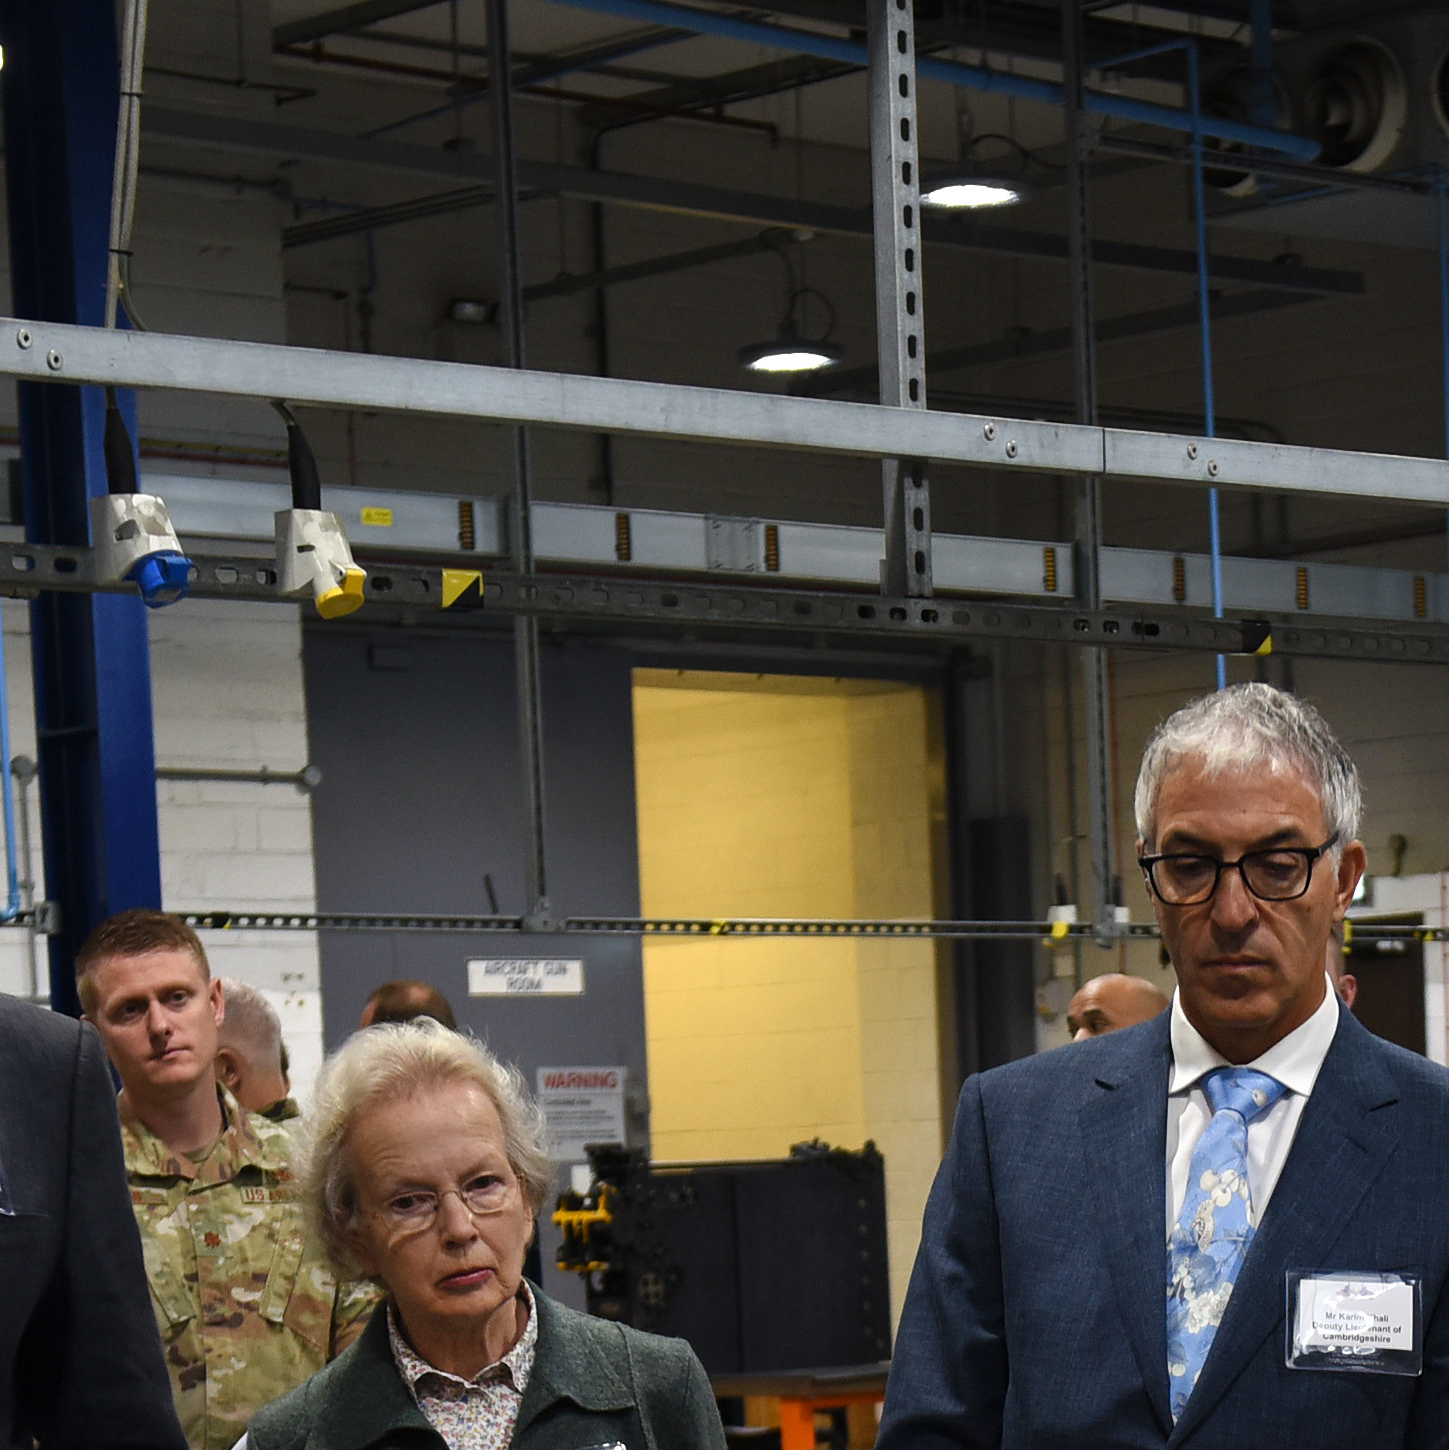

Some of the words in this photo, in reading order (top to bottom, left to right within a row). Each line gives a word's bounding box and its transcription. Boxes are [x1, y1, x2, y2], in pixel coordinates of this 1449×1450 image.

[484, 960, 539, 976] AIRCRAFT
[543, 960, 569, 976] GUN
[506, 976, 543, 991] ROOM
[543, 1071, 618, 1090] WARNING
[245, 1187, 266, 1201] US
[1325, 1311, 1337, 1321] Mr
[1392, 1325, 1402, 1334] of
[1322, 1333, 1391, 1344] Cambridgeshire
